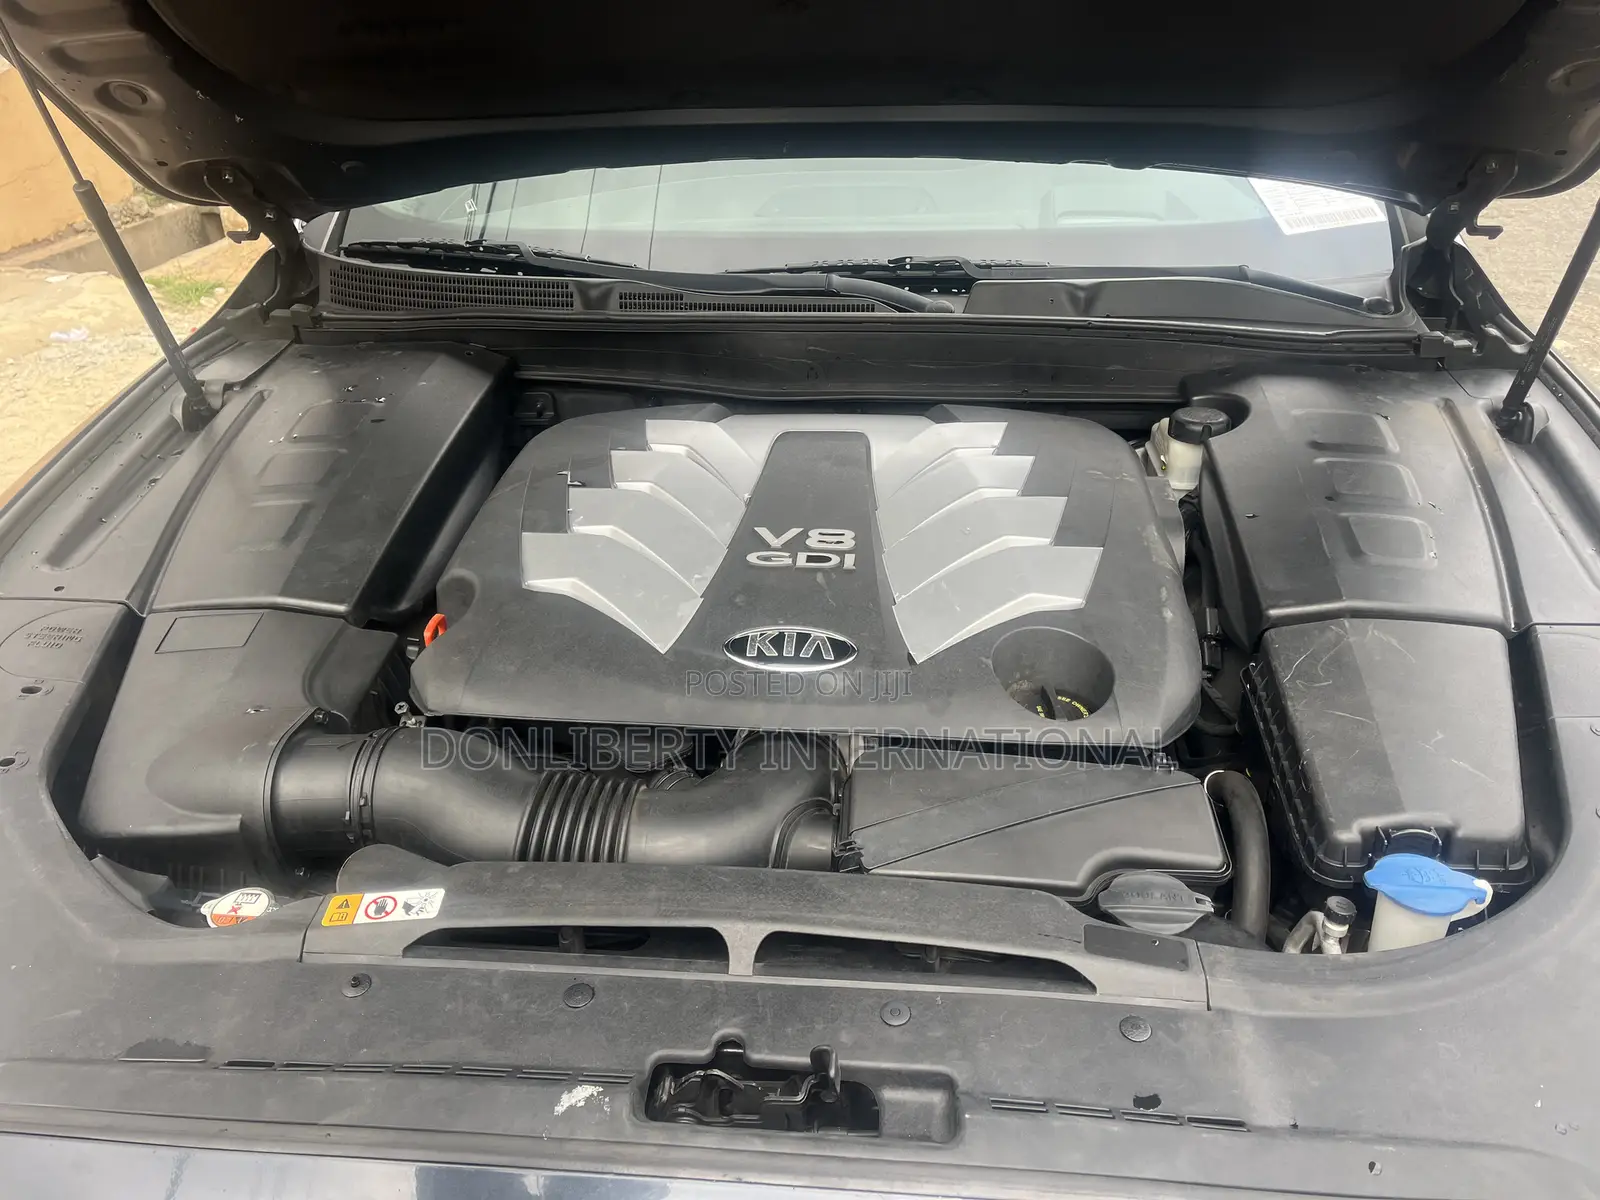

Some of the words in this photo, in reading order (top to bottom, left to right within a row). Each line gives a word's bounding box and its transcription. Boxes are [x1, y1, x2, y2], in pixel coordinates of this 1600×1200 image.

[753, 527, 857, 549] V8
[746, 551, 857, 569] GDI
[40, 625, 83, 634] POWER
[24, 633, 83, 642] STEERING
[27, 640, 64, 649] FLUID
[746, 631, 835, 660] KIA
